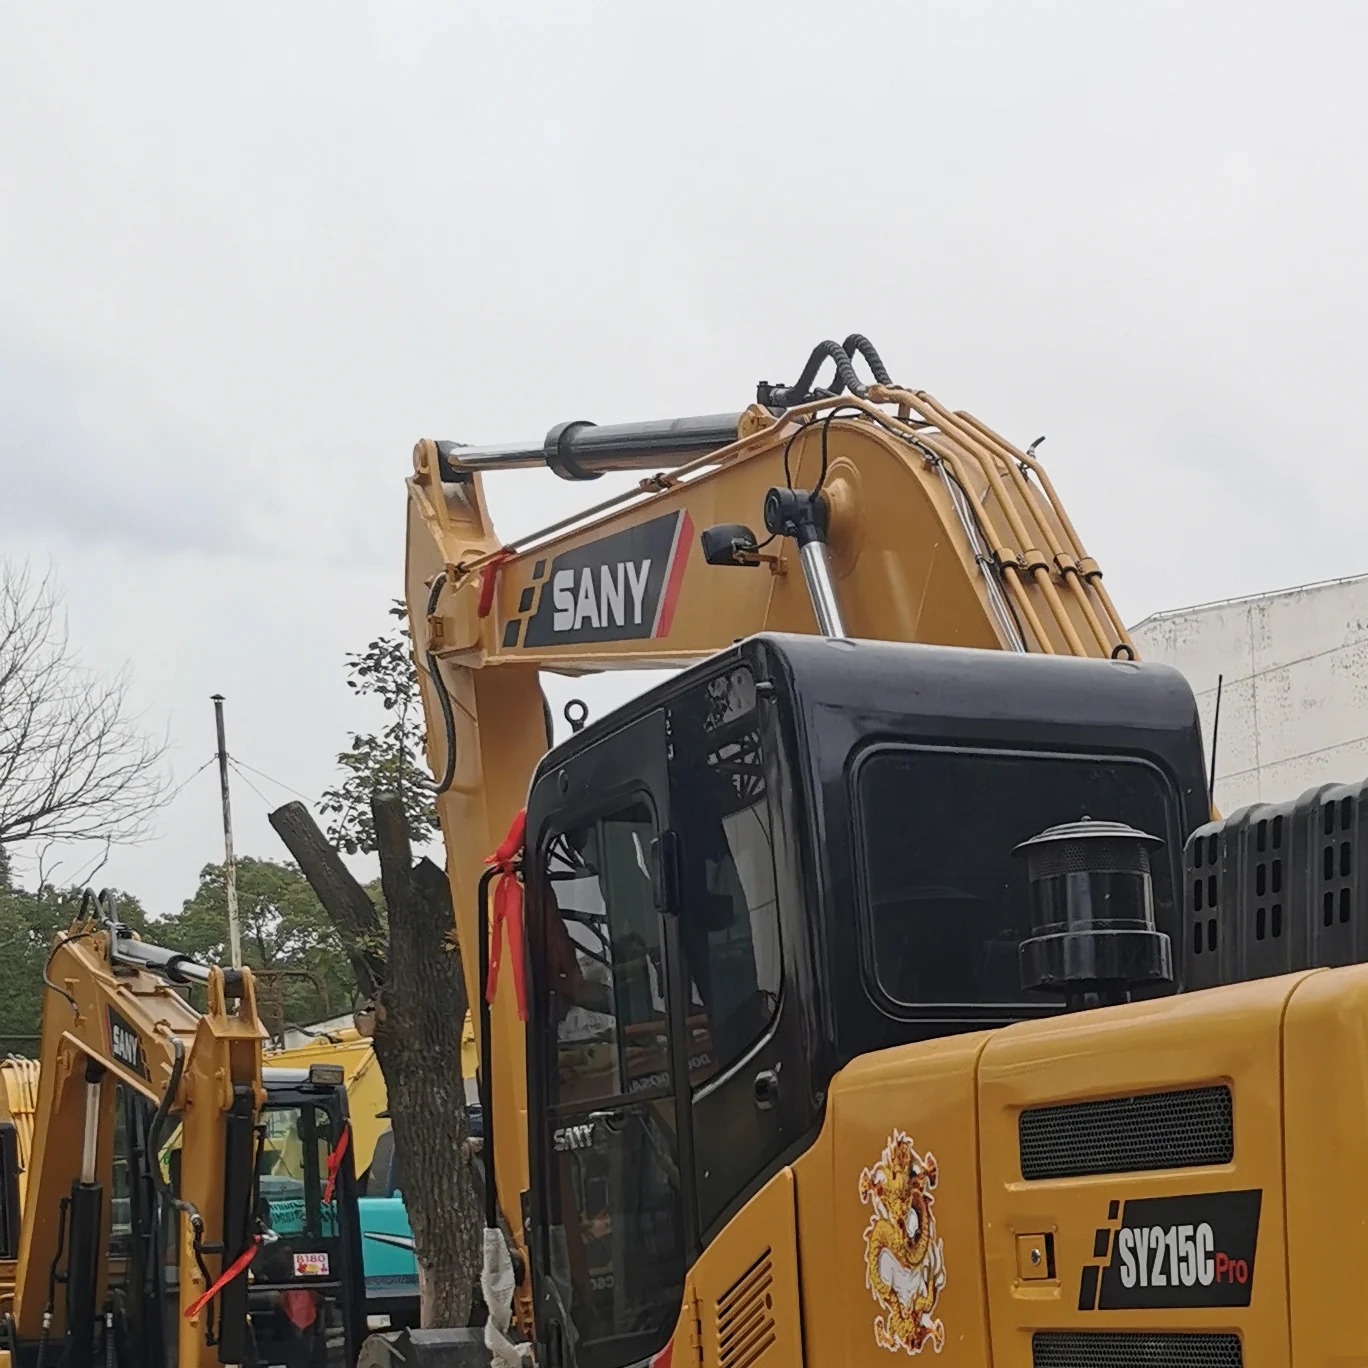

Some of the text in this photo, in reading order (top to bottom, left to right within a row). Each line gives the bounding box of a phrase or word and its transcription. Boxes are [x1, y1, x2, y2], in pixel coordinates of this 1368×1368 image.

[553, 559, 651, 632] SANY
[112, 1024, 138, 1066] SANY
[553, 1123, 595, 1151] SANY
[1119, 1222, 1249, 1288] SY215C Pro
